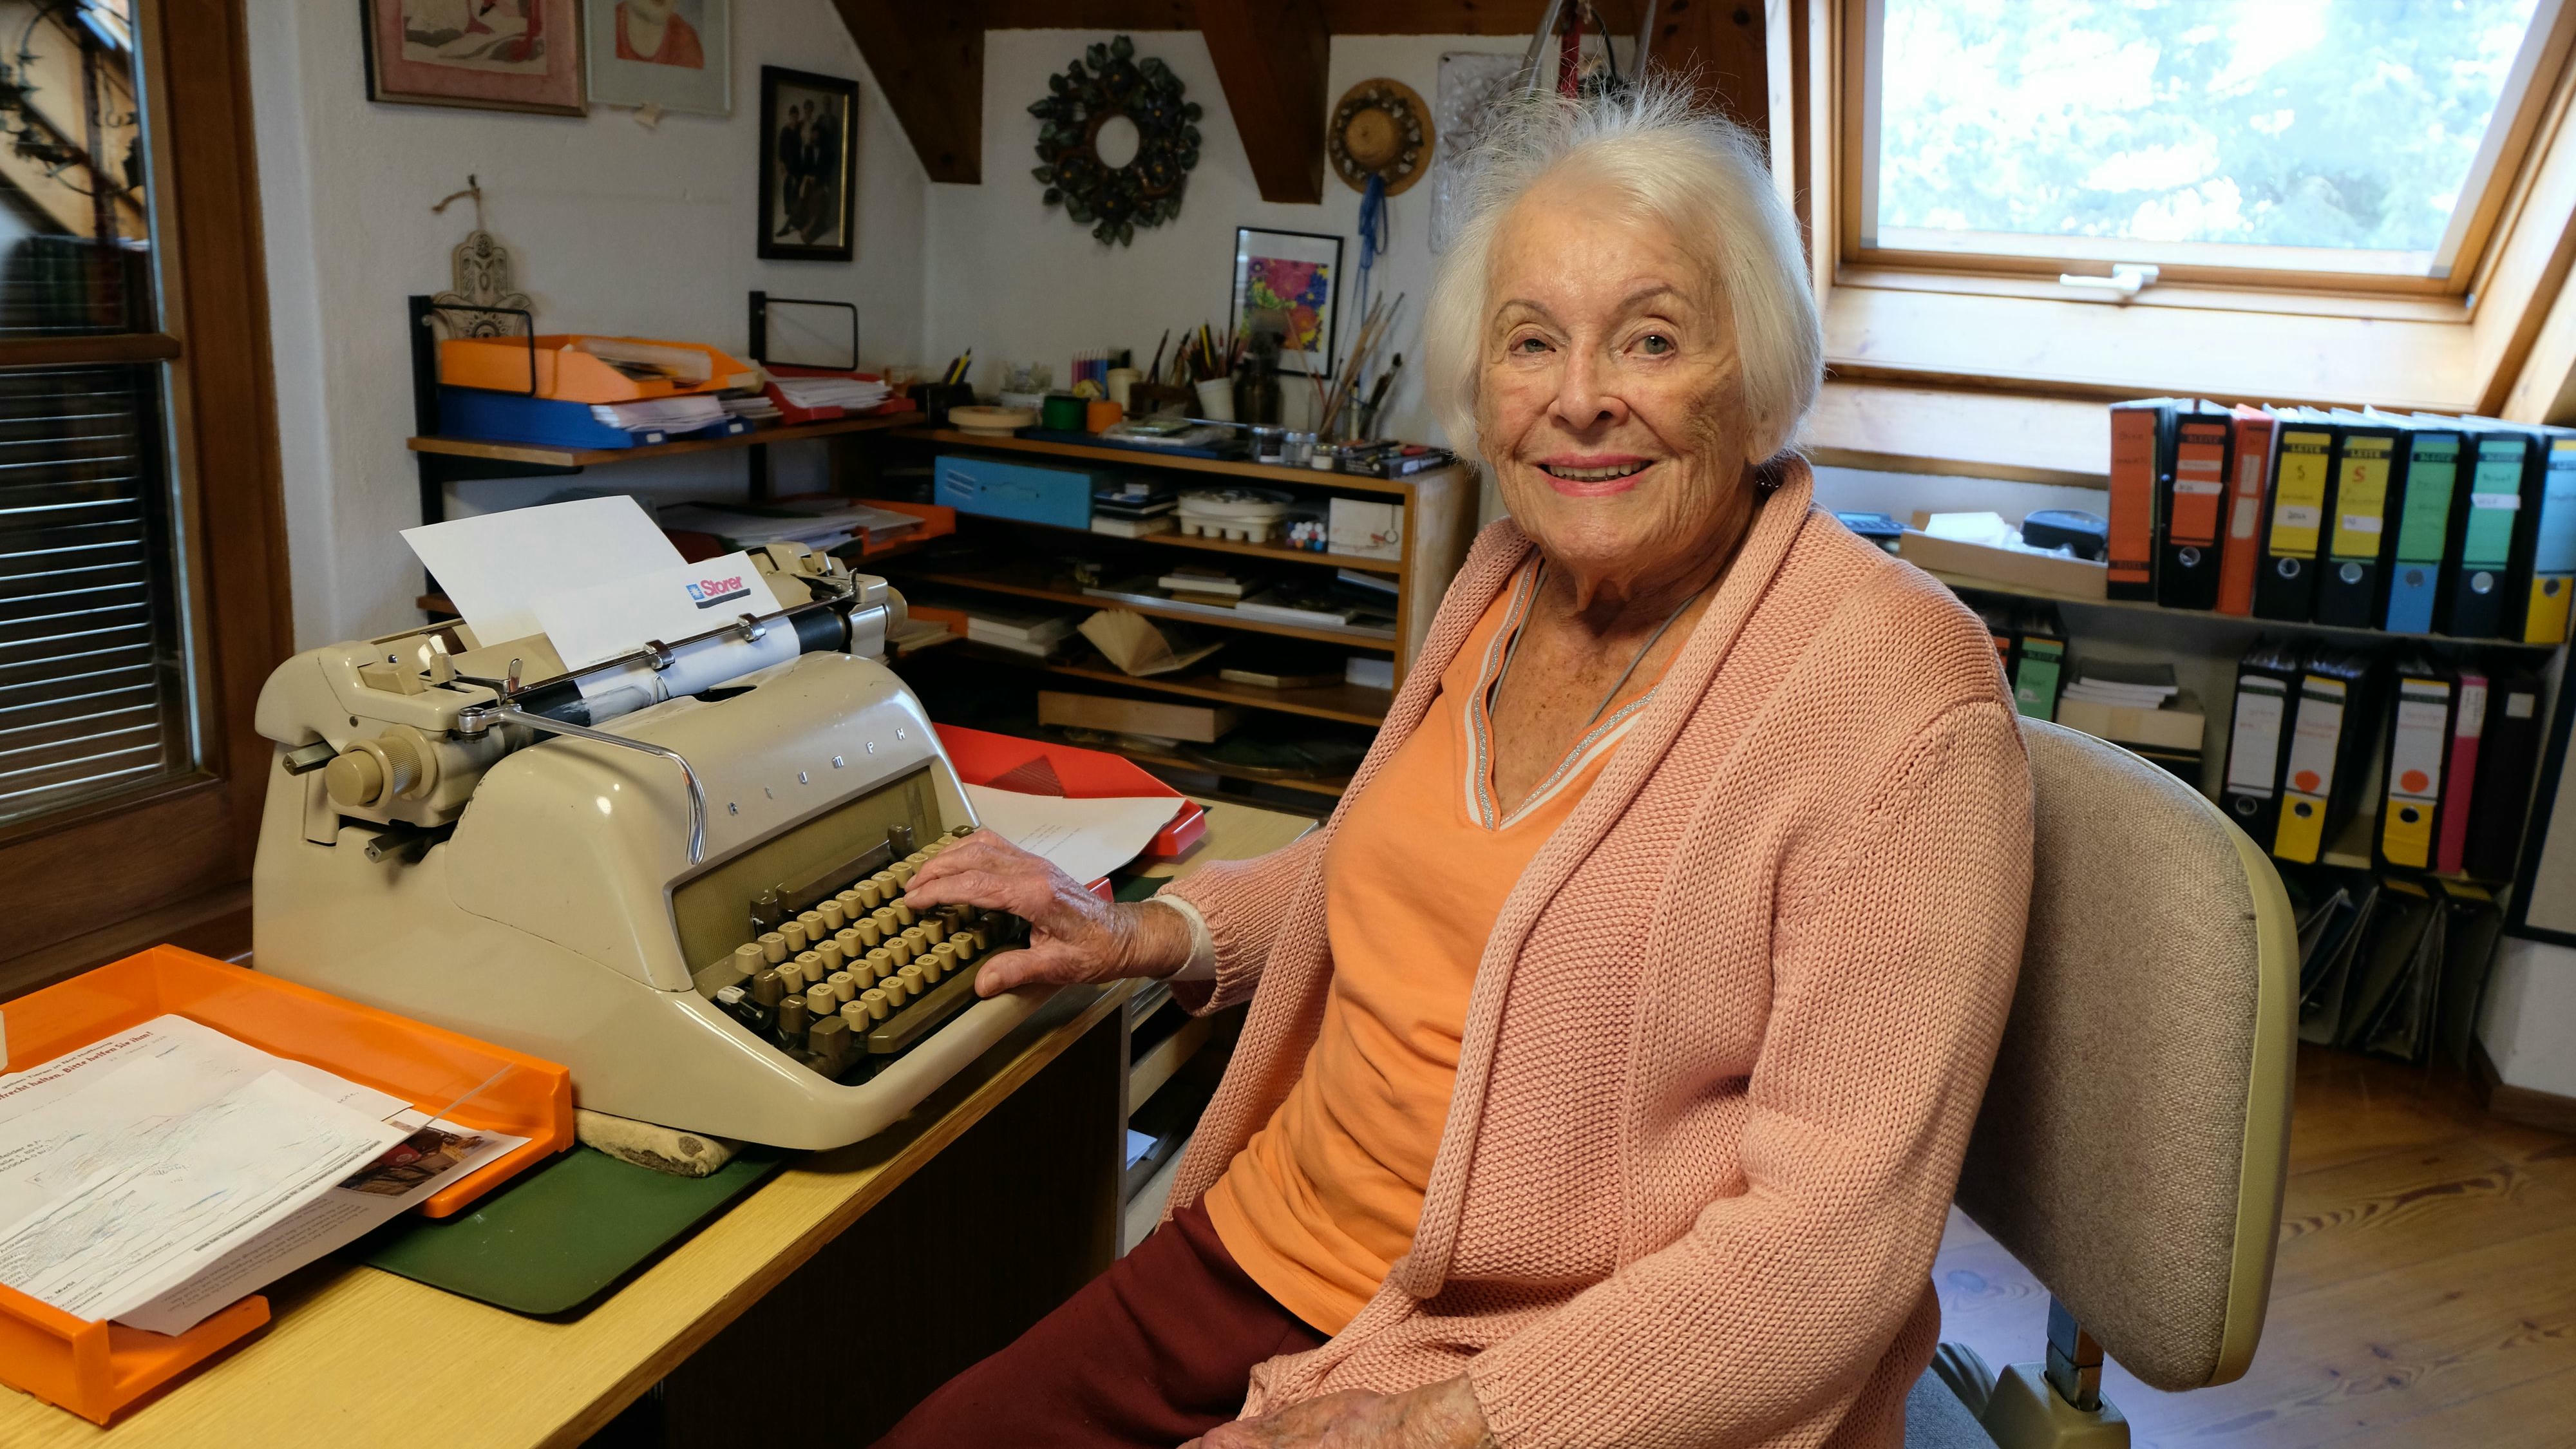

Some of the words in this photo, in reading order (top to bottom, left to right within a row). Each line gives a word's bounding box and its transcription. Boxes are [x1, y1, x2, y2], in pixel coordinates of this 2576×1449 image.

[2353, 466, 2366, 482] S
[700, 576, 743, 596] Storer
[728, 728, 905, 816] RIUMPH
[28, 1073, 64, 1086] halten.
[62, 1060, 86, 1074] Bitte
[86, 1046, 117, 1062] helfen
[115, 1041, 130, 1049] Sie
[129, 1031, 154, 1043] ihm!
